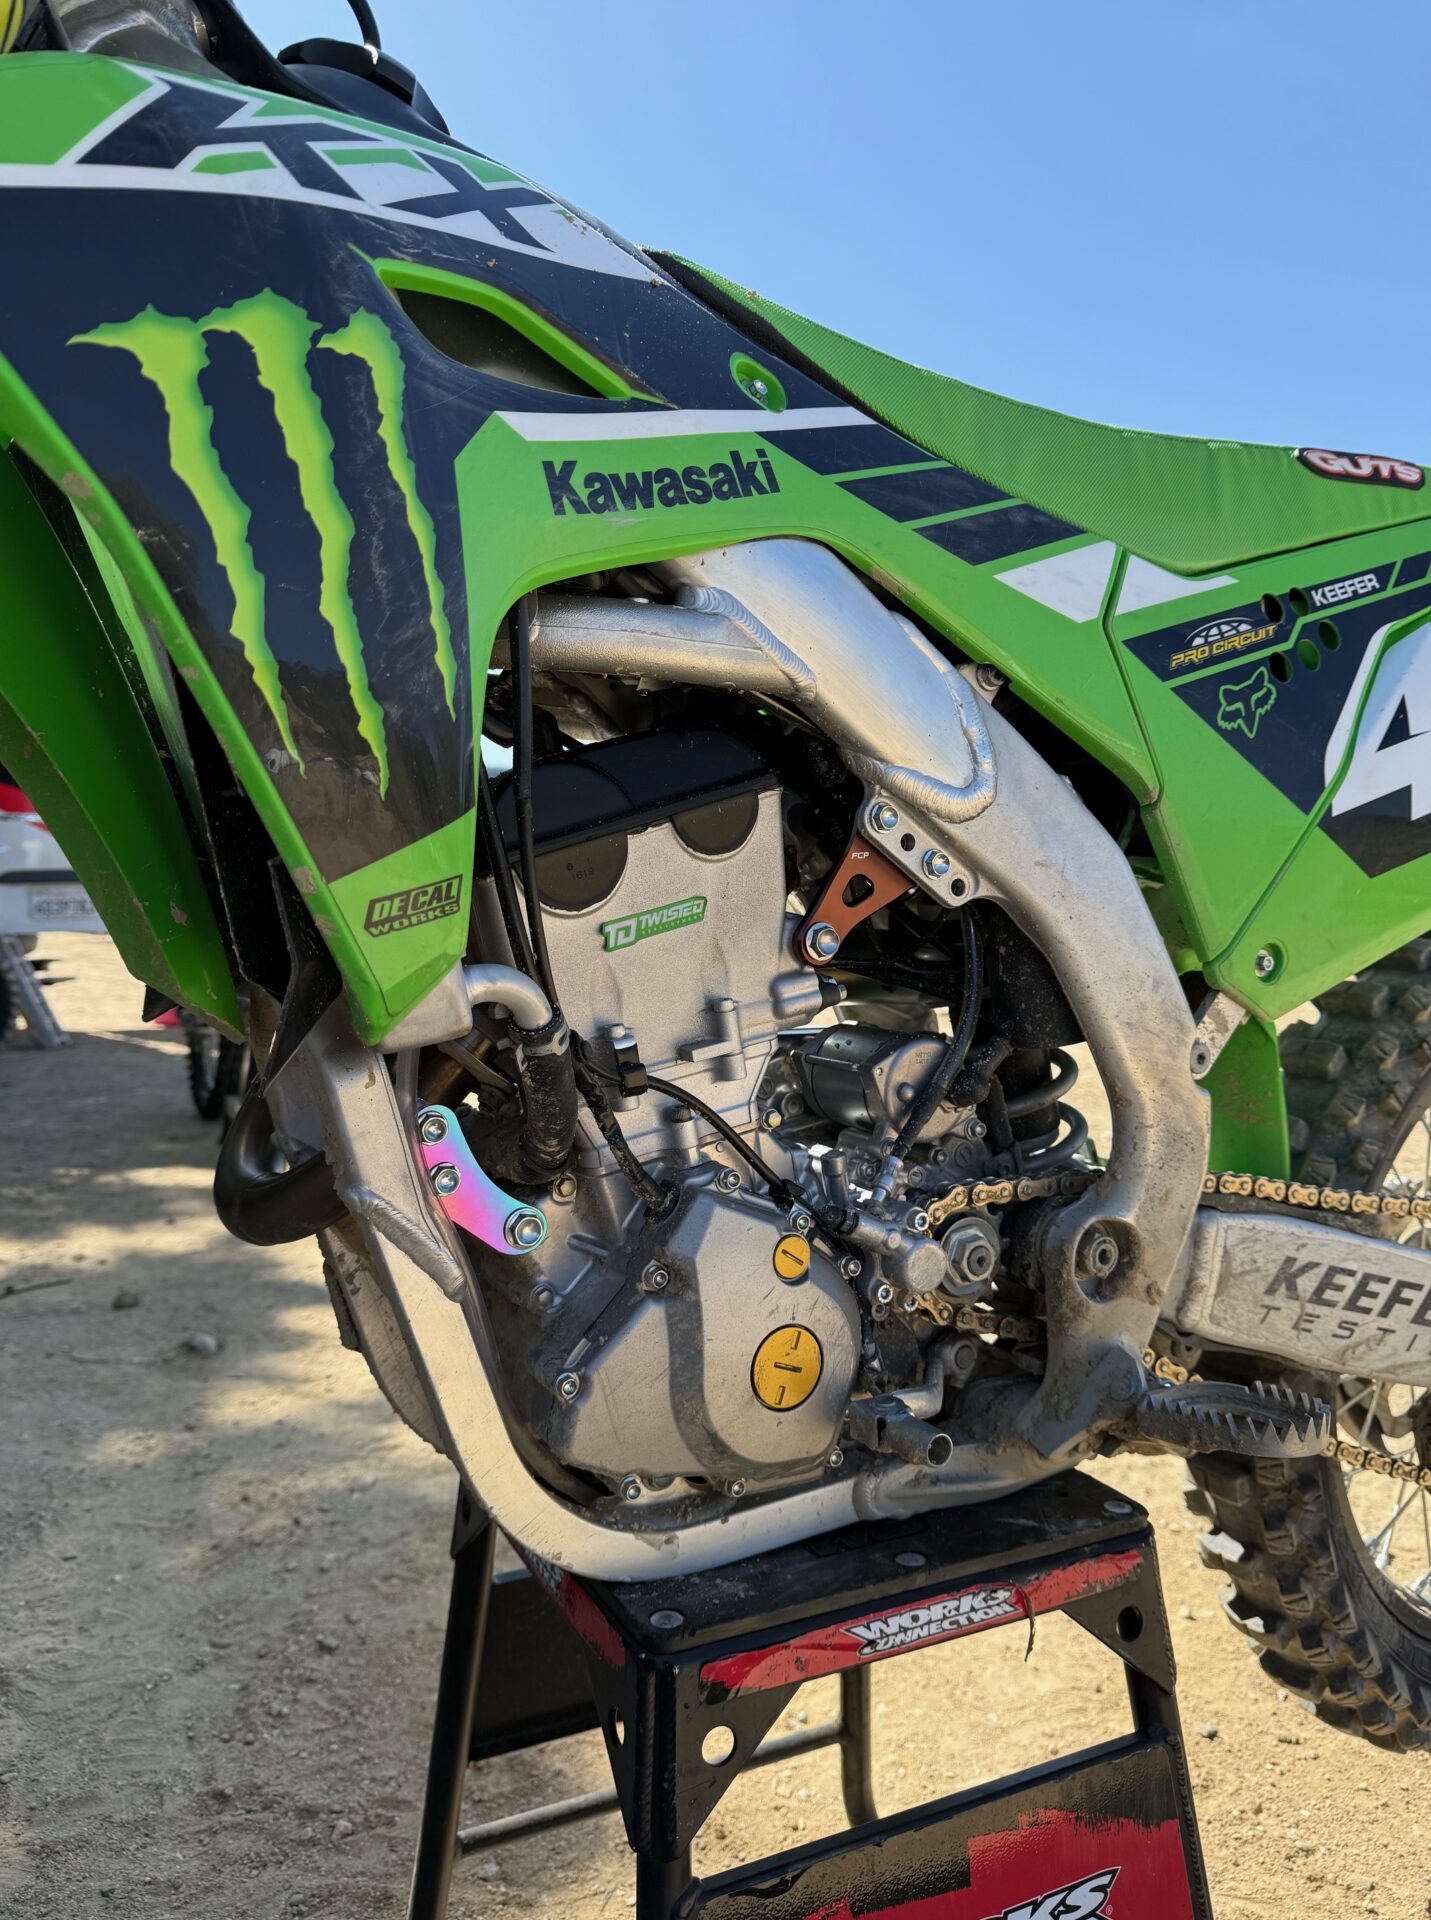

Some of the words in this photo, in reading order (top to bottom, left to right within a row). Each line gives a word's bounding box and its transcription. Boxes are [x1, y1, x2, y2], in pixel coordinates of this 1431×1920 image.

[541, 448, 781, 516] Kawasaki
[1303, 450, 1422, 484] GUTS
[1311, 573, 1380, 607] KEEFER
[1169, 647, 1210, 670] PRO
[1211, 624, 1278, 655] CIRCUIT
[851, 851, 870, 860] FCP
[368, 903, 459, 936] WORKS
[371, 878, 460, 923] DECAL
[640, 899, 706, 930] TWISTED
[1260, 1304, 1431, 1356] TESTI
[849, 1588, 1013, 1641] WORKS
[858, 1602, 1018, 1656] CONNECTION
